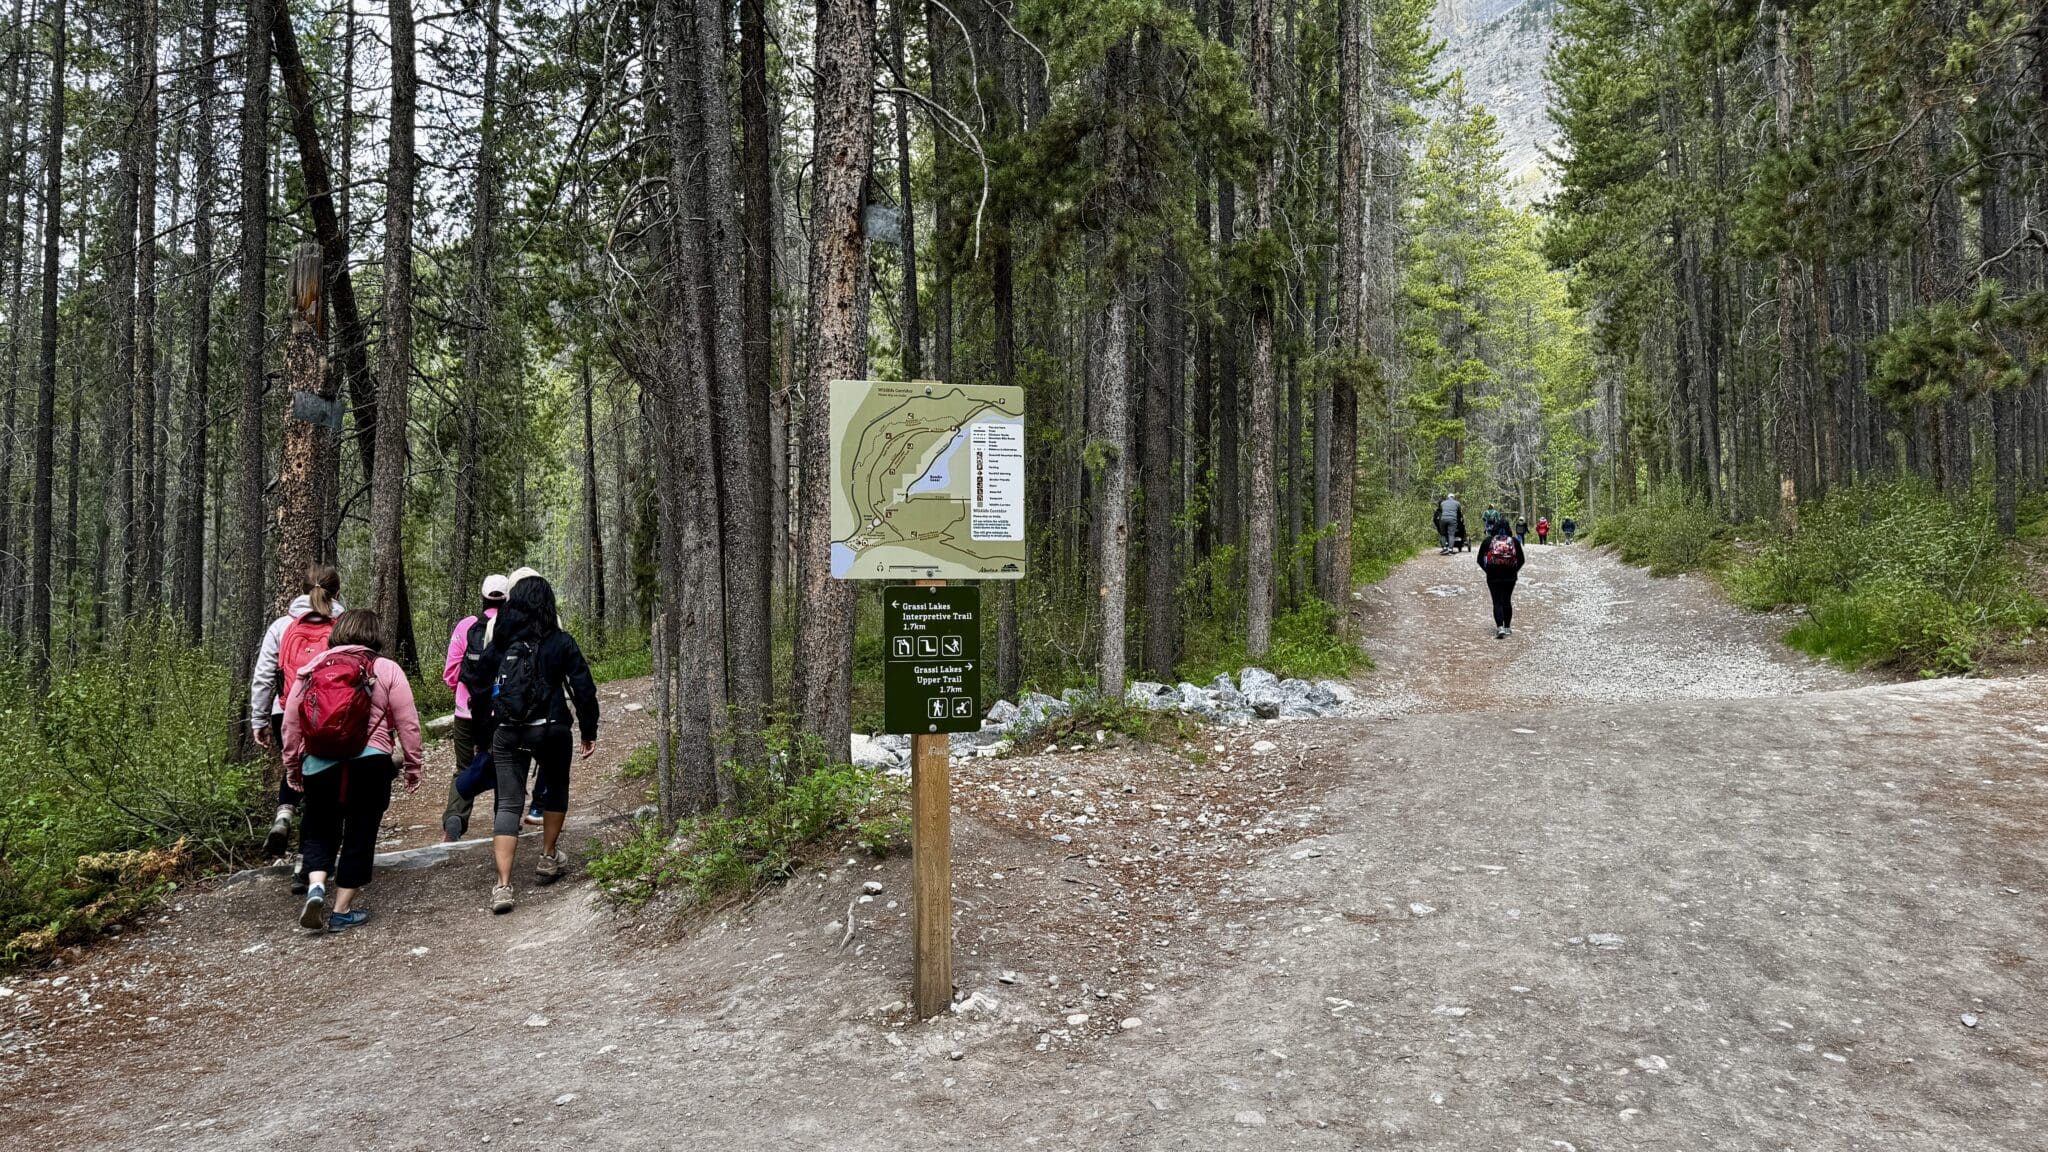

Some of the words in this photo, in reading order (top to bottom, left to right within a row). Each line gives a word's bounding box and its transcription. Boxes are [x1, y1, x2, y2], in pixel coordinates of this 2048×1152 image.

[902, 602, 927, 610] Grassi
[928, 602, 951, 610] Lakes
[902, 613, 951, 622] Interpretive
[952, 612, 972, 620] Trail
[903, 623, 926, 631] 1.7km
[914, 666, 939, 674] Grassi
[940, 665, 962, 673] Lakes
[916, 676, 941, 685] Upper
[942, 675, 962, 683] Trail
